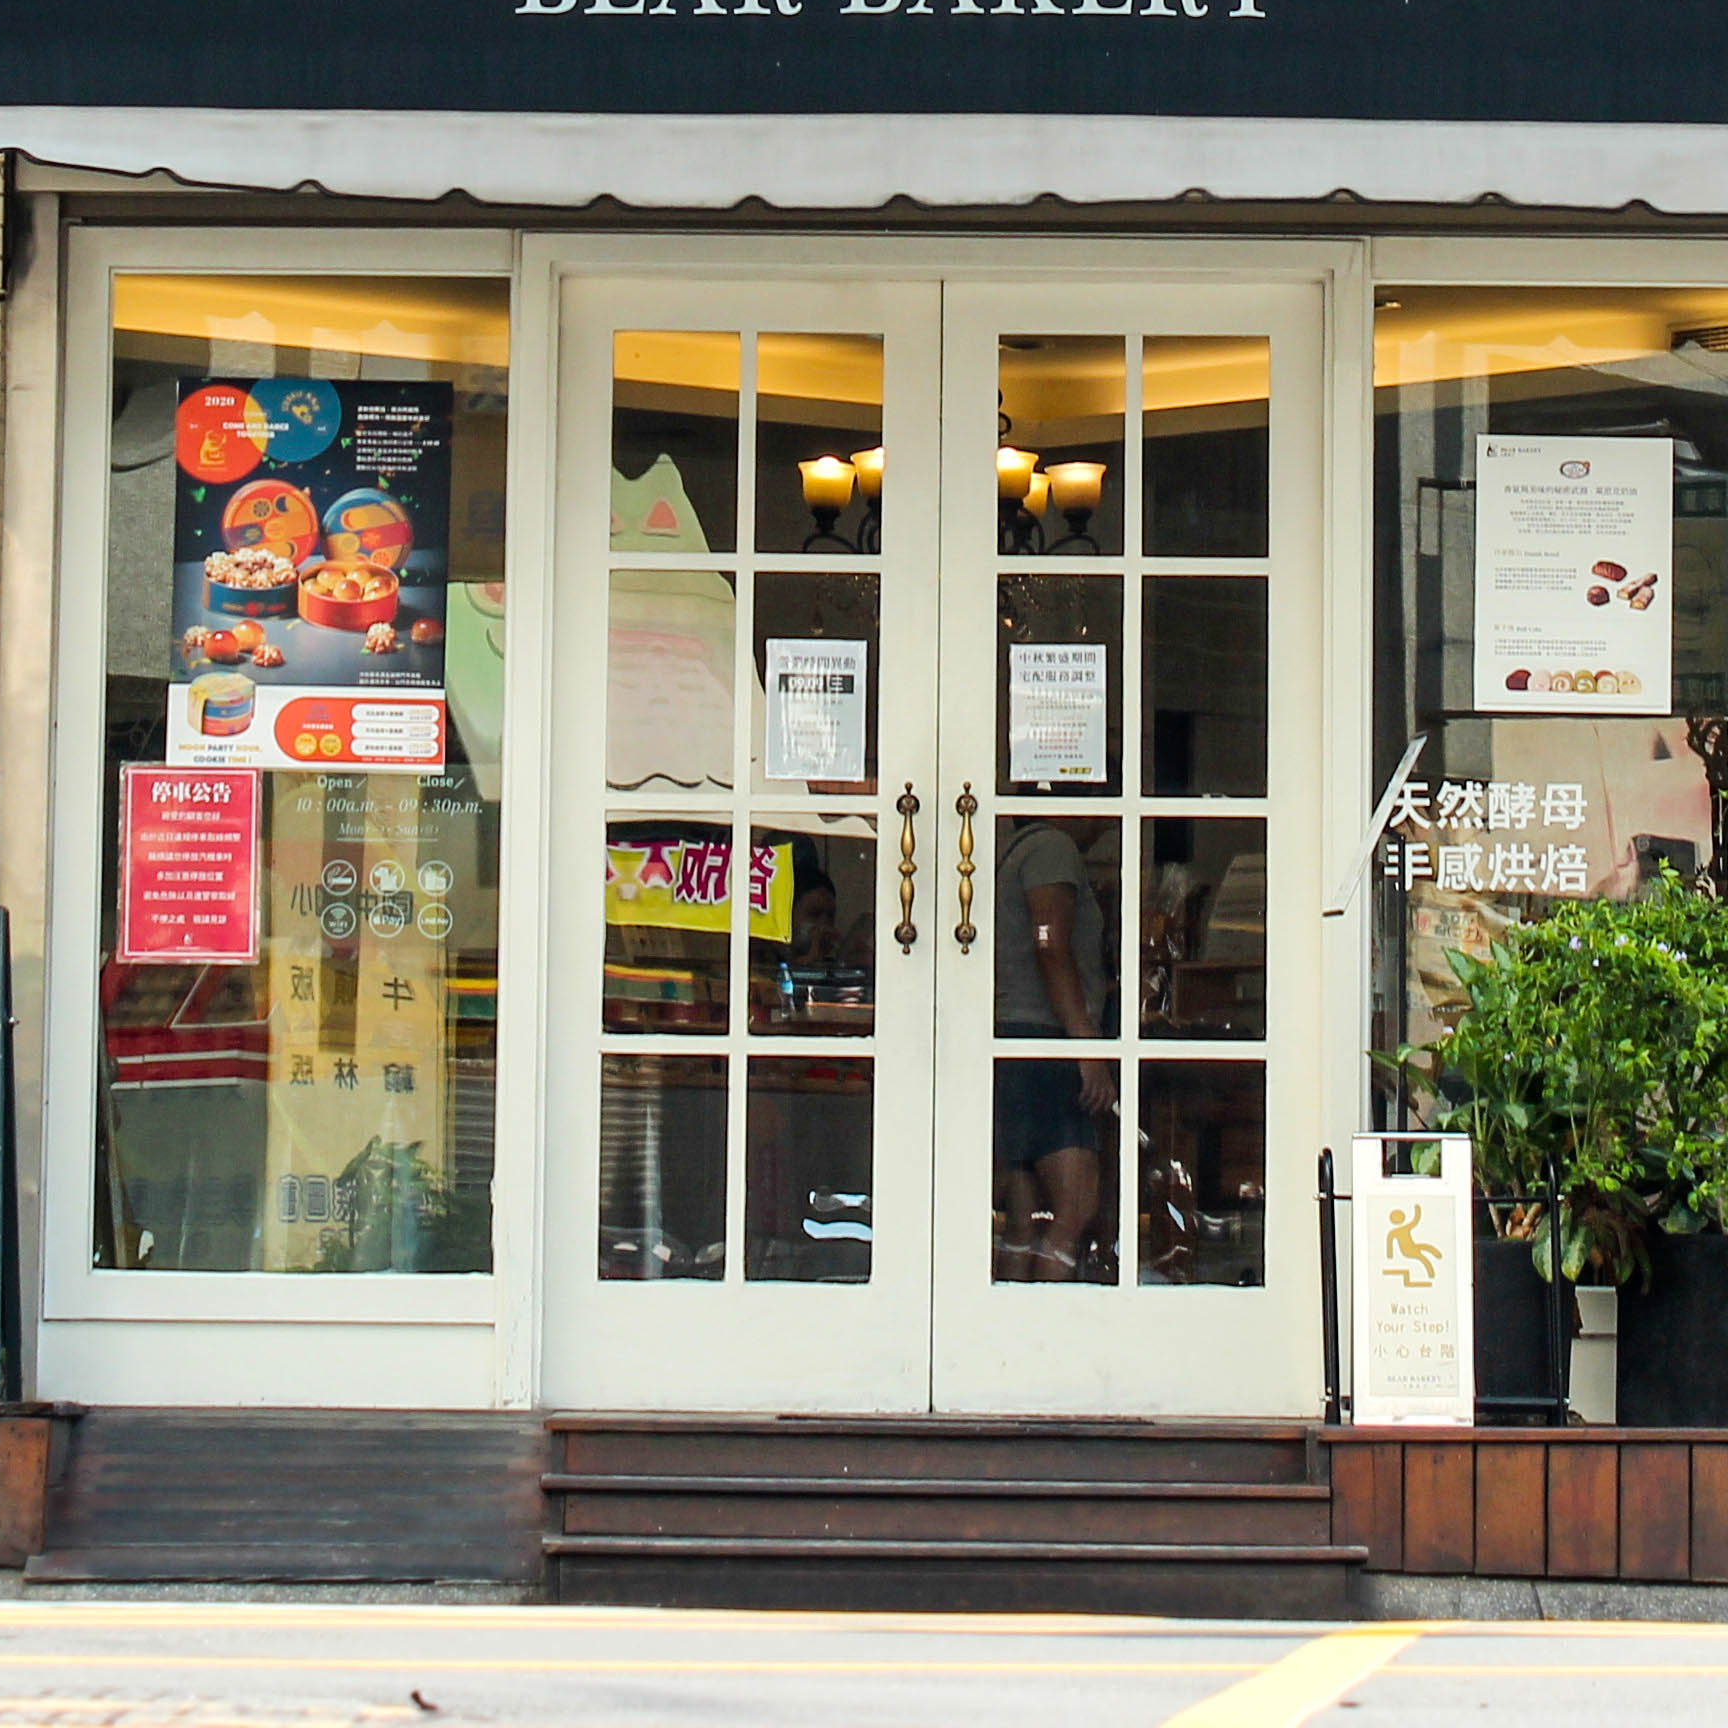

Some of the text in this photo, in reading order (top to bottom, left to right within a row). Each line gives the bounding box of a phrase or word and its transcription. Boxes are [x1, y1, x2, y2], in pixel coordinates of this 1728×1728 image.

[204, 395, 235, 407] 2020
[316, 774, 353, 790] Open
[151, 780, 233, 805] 停車公告
[1388, 779, 1589, 831] 天然酵母
[1383, 842, 1589, 892] 手感烘焙
[1390, 1303, 1430, 1315] Watch
[1375, 1319, 1450, 1334] Your Step!
